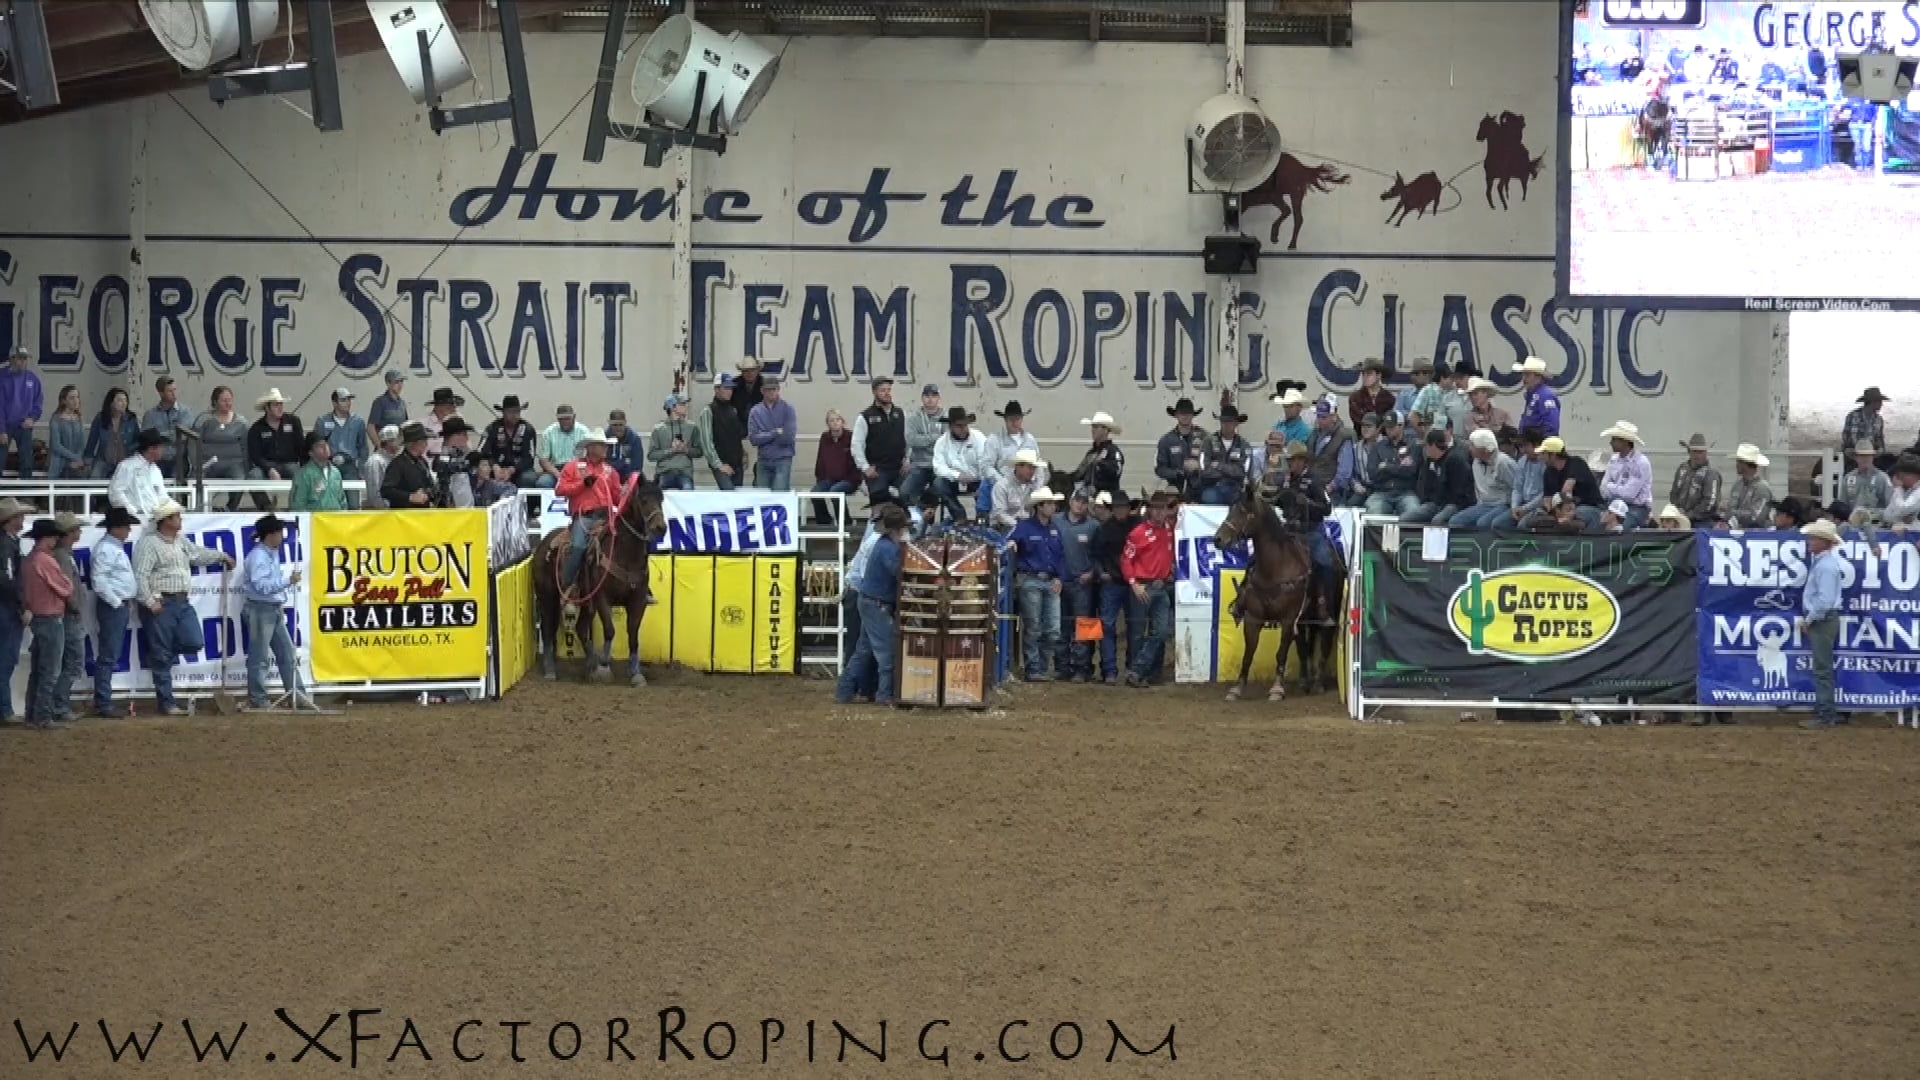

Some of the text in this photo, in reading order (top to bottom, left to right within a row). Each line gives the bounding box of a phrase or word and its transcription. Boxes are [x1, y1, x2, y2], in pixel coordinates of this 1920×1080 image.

[448, 148, 1105, 242] Home of the
[1745, 298, 1891, 311] Real Screen Video.Com
[0, 250, 305, 374] EORGE
[334, 253, 637, 379] STRAIT
[947, 264, 1269, 390] ROPING
[1306, 269, 1668, 397] CLASSIC
[647, 504, 792, 552] NDER
[324, 541, 473, 597] BRUTON
[352, 575, 446, 606] Easy Pull
[1498, 584, 1588, 613] CACTUS
[321, 602, 475, 630] TRAILERS
[769, 563, 782, 669] CACTUS
[1513, 614, 1593, 643] ROPES
[342, 635, 369, 649] SAN
